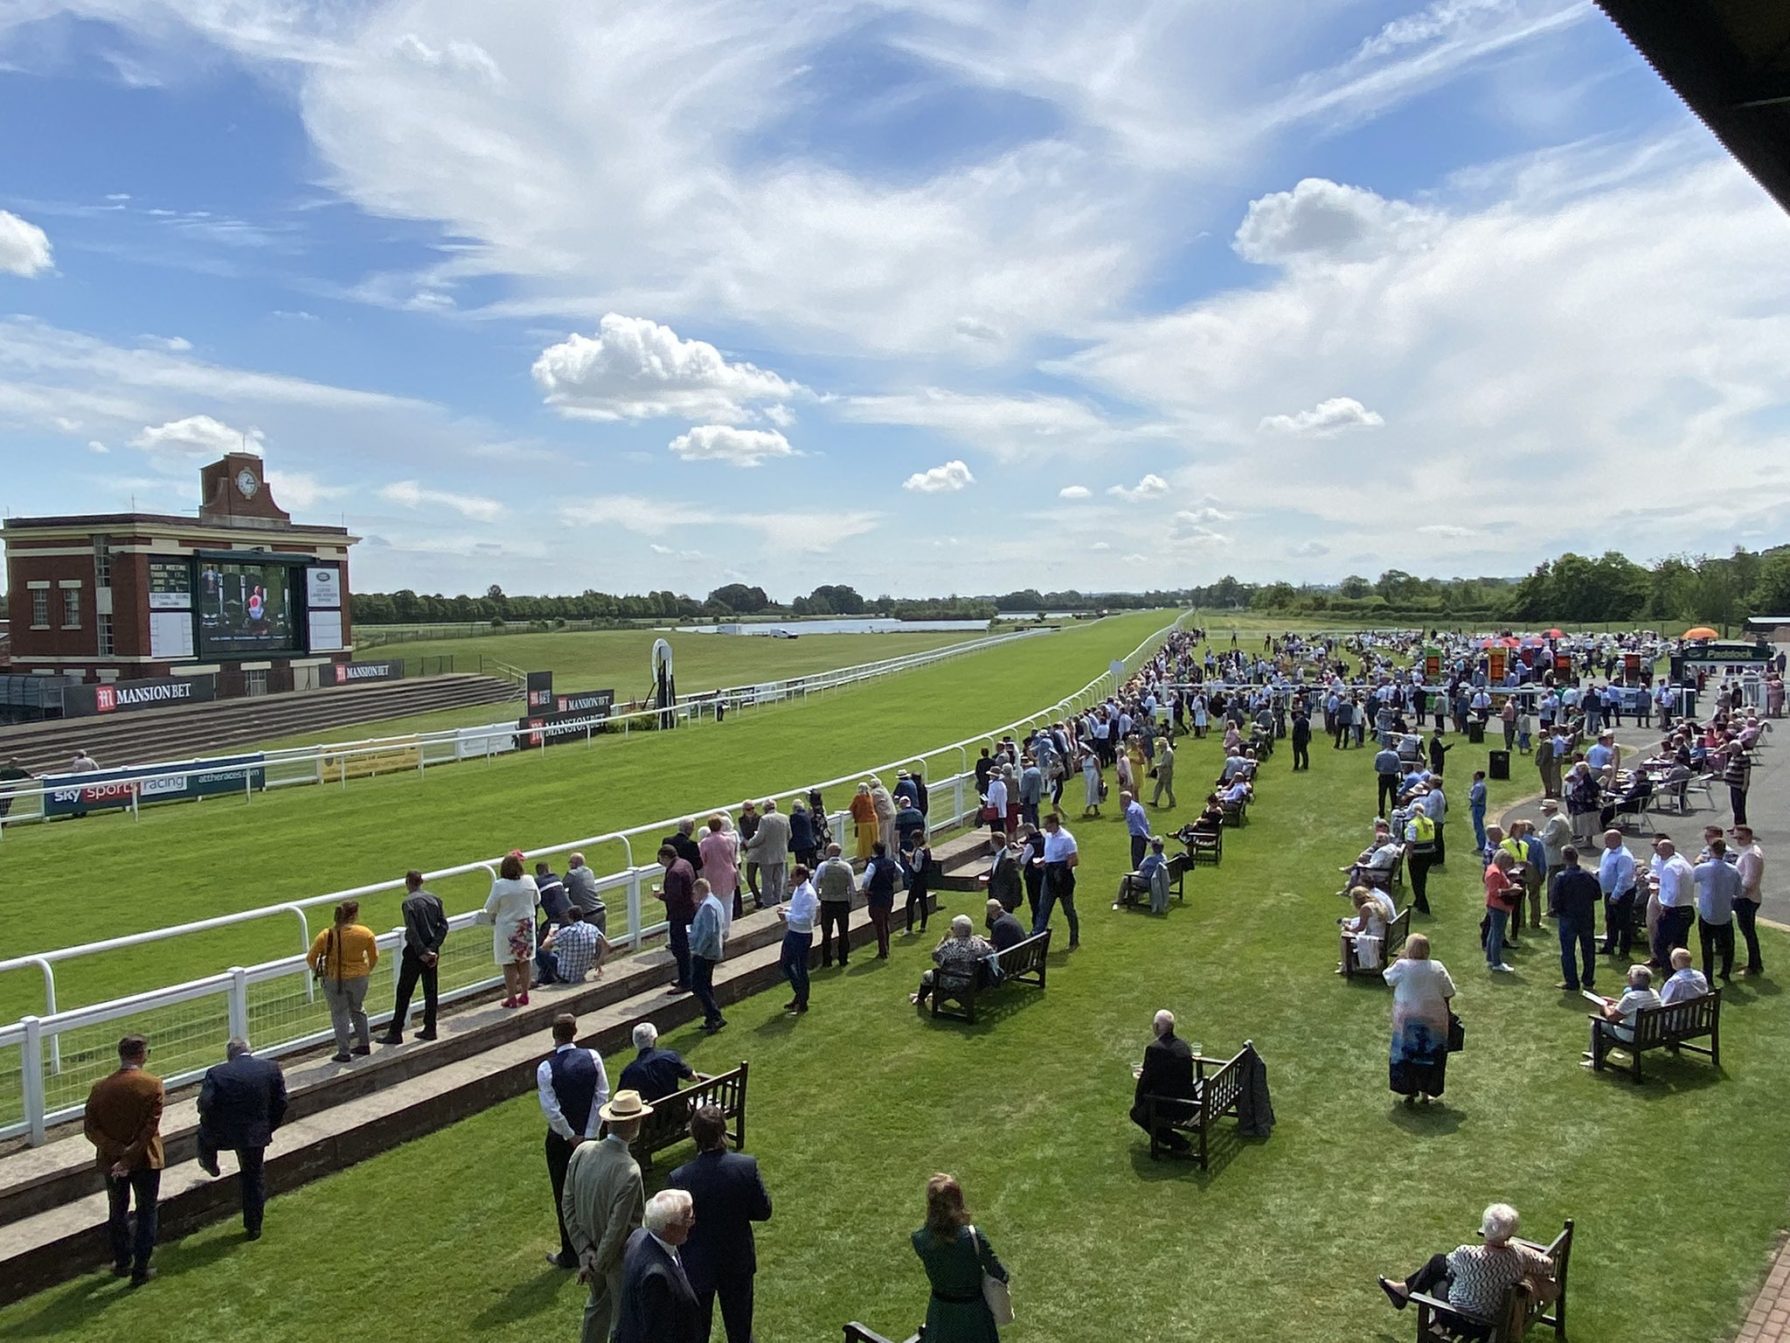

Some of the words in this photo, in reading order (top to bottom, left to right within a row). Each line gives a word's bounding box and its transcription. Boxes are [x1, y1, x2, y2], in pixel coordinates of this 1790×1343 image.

[54, 789, 81, 803] sky
[143, 776, 184, 790] racing
[198, 769, 260, 783] attheraces.cm
